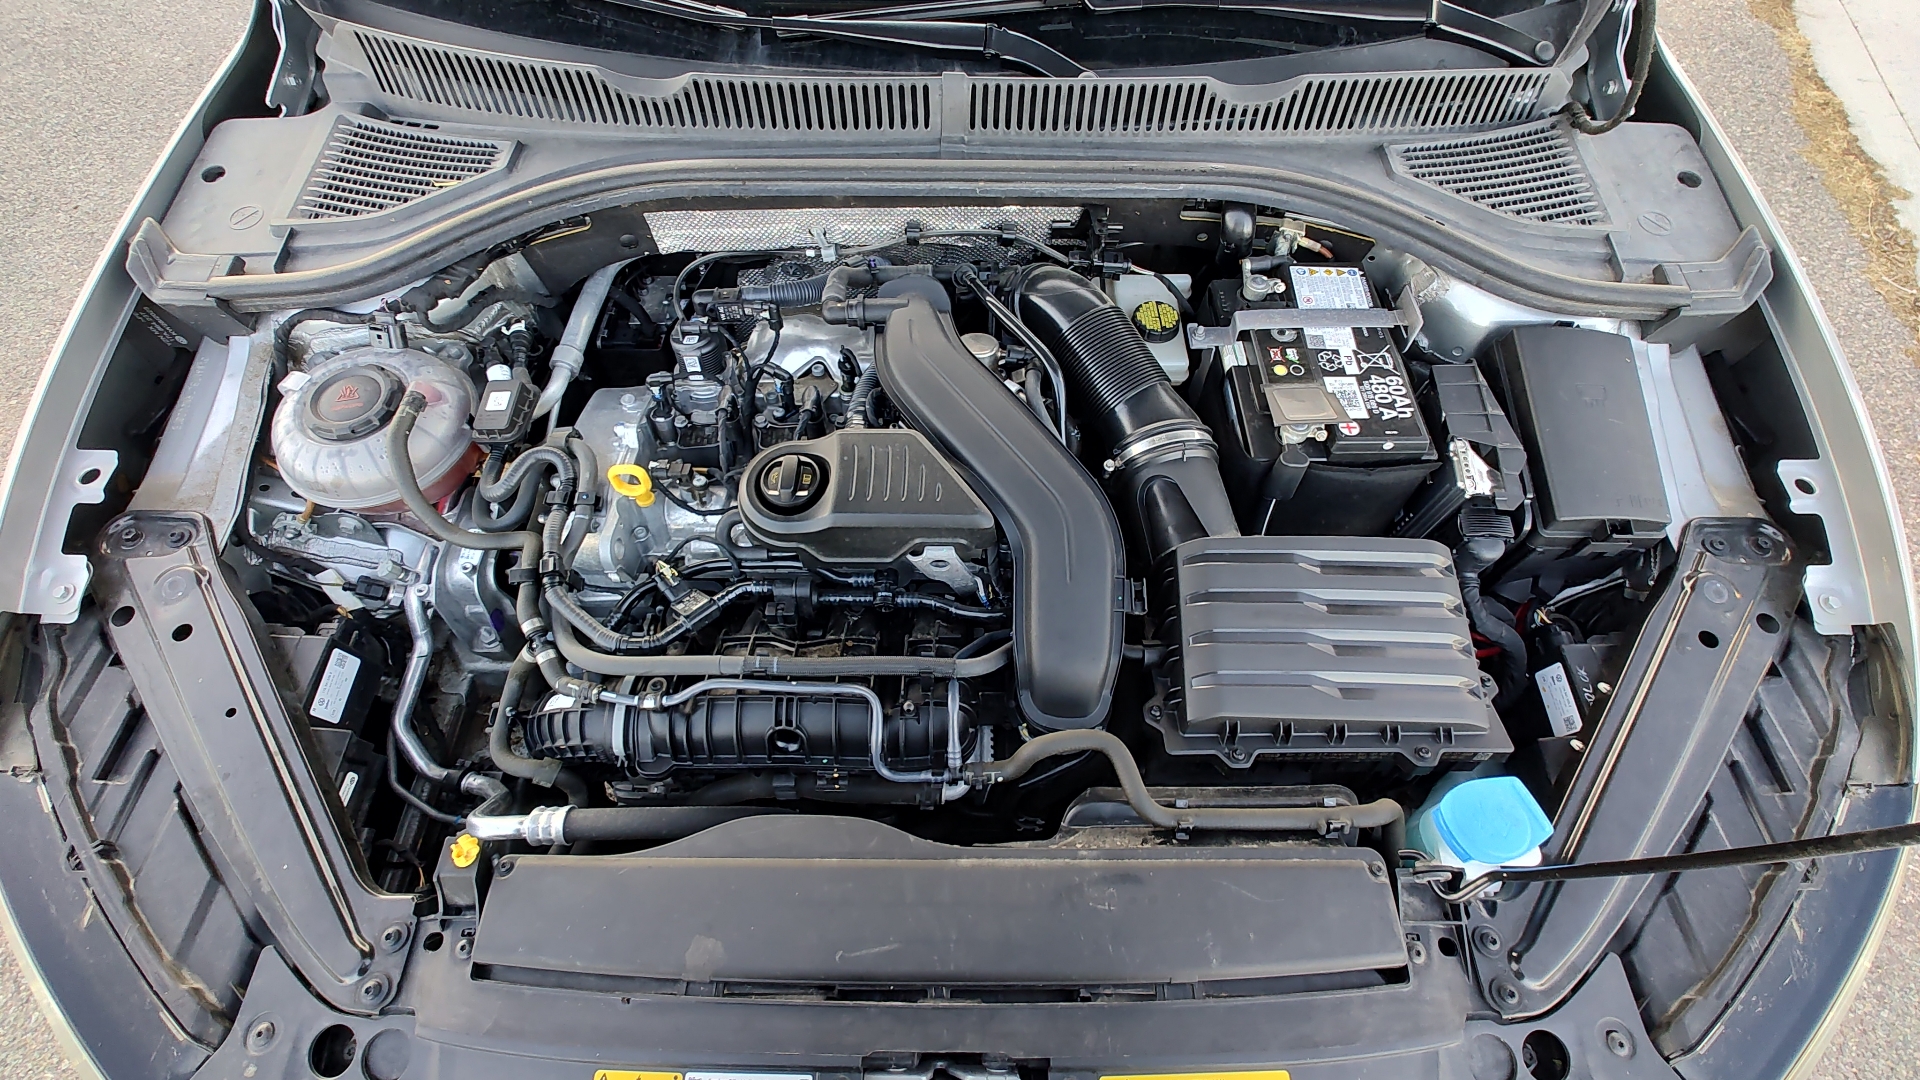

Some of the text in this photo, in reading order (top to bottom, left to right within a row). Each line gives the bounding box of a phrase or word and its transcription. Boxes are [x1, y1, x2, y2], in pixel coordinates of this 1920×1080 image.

[1343, 355, 1353, 366] Pb
[1369, 374, 1393, 404] 480
[1385, 375, 1415, 419] 60Ah
[1379, 406, 1398, 421] A
